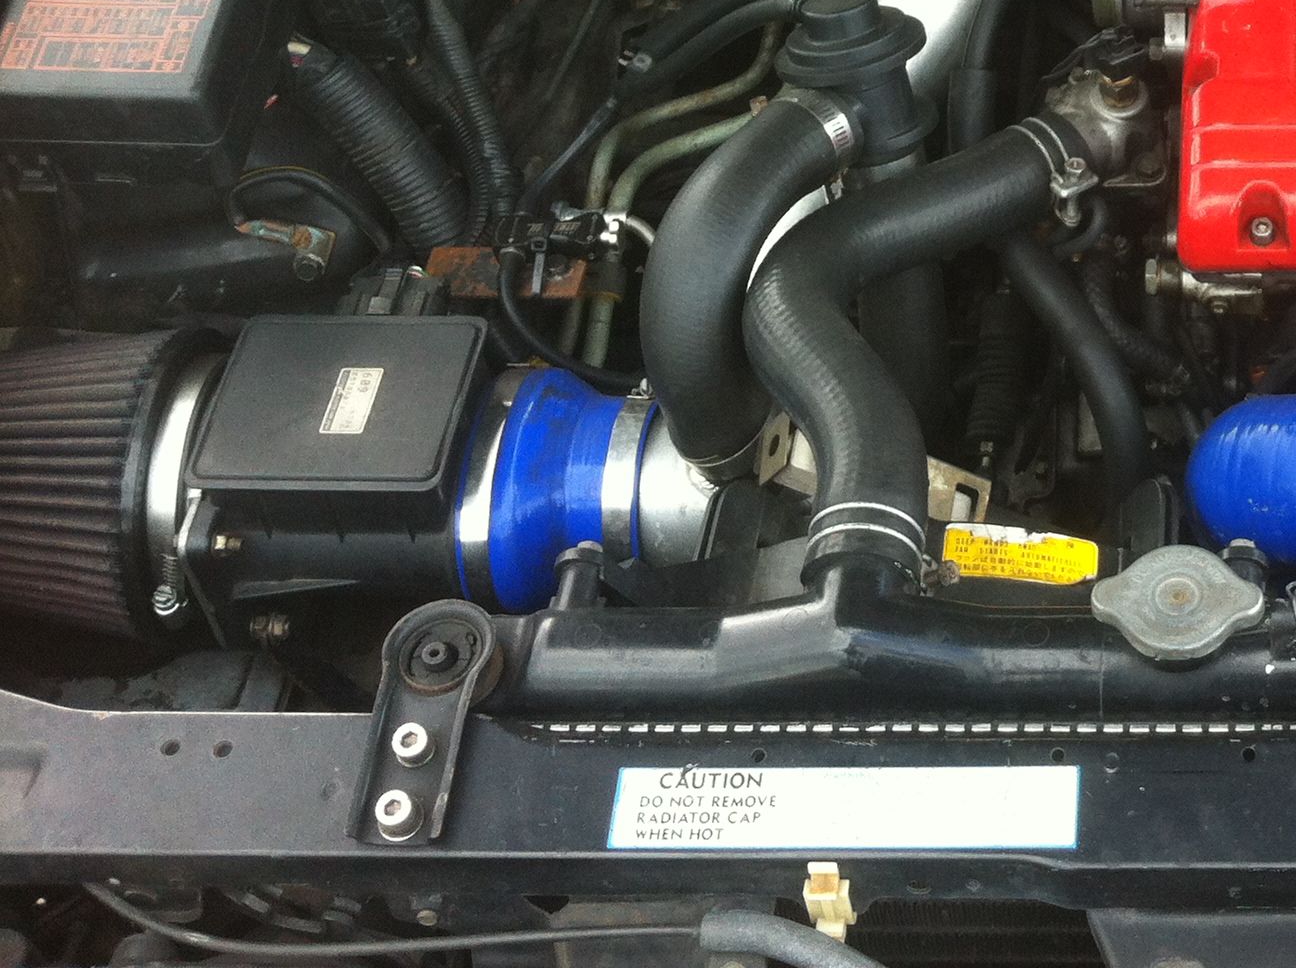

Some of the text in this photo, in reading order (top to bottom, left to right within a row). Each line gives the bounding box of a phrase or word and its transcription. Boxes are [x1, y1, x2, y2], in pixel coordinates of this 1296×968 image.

[660, 772, 763, 789] CAUTION
[640, 795, 776, 807] DO NOT REMOVE
[637, 811, 761, 824] RADIATOR CAP
[636, 828, 724, 840] WHEN HOT
